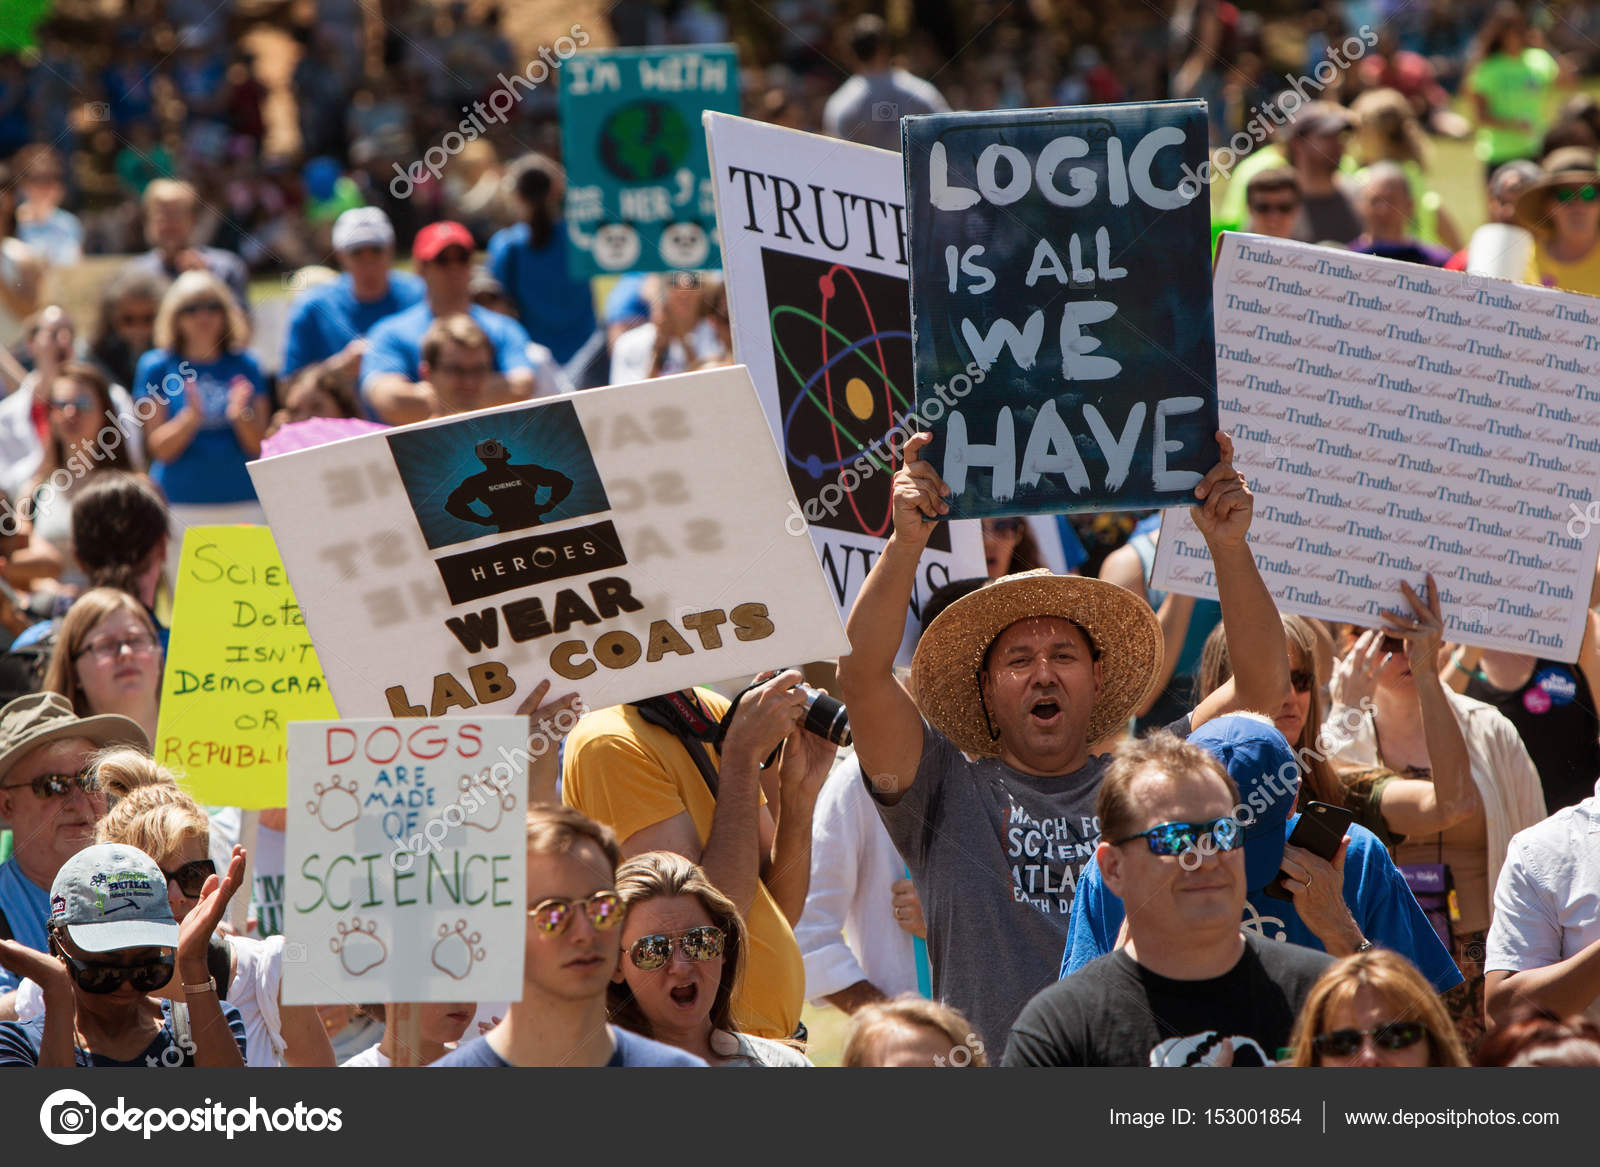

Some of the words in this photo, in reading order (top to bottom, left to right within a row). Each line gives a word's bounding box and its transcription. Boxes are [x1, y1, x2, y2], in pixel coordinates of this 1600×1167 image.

[929, 127, 1195, 211] LOGIC
[945, 244, 996, 294] IS
[1025, 226, 1128, 288] ALL
[961, 301, 1123, 381] WE
[1219, 397, 1241, 413] ruth
[942, 396, 1204, 502] HAVE
[488, 480, 522, 491] SCIENCE
[471, 541, 597, 582] HEROES
[445, 576, 644, 654] WEAR
[225, 644, 314, 663] ISN'T
[384, 661, 516, 718] LAB
[549, 602, 775, 682] COATS
[173, 669, 326, 695] DEMOCRA
[234, 709, 281, 731] OR
[164, 737, 289, 768] REPUBLI
[326, 724, 483, 766] DOGS
[375, 766, 426, 788] ARE
[364, 787, 436, 808] MADE
[381, 811, 420, 840] OF
[108, 880, 152, 891] BUILD
[295, 851, 512, 913] SCIENCE
